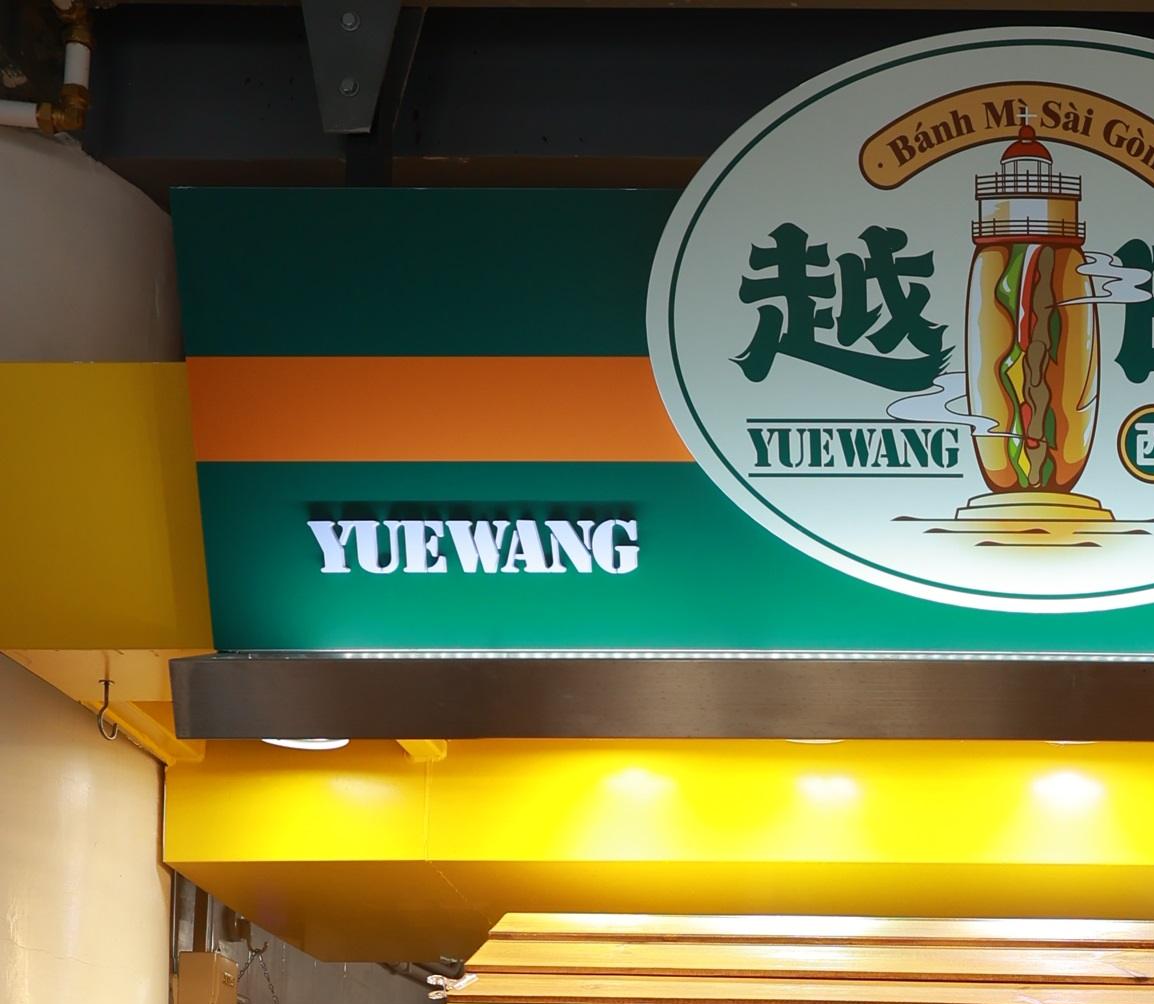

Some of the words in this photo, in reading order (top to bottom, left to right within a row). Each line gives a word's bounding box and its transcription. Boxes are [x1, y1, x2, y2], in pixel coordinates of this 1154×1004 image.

[887, 109, 976, 167] Bánh
[1040, 101, 1094, 133] Sài
[747, 427, 961, 470] YUEWANG
[306, 519, 640, 574] YUEWANG
